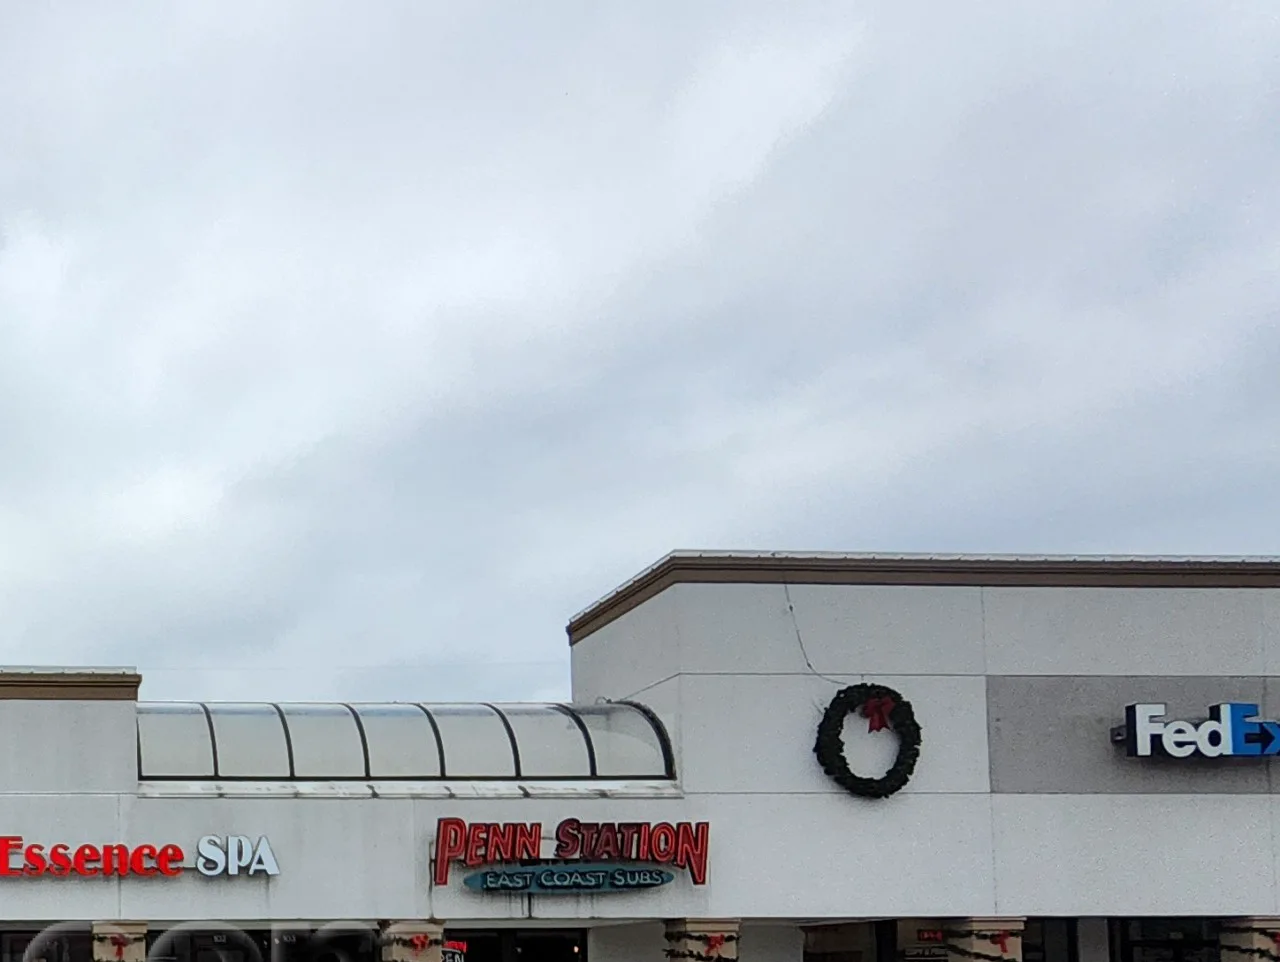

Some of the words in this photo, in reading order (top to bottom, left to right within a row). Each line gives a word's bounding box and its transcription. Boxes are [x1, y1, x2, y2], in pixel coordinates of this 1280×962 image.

[196, 833, 280, 877] SPA
[434, 817, 542, 886] PENN
[554, 817, 709, 885] STATION
[484, 872, 532, 887] EAST
[540, 871, 605, 886] COAST
[614, 869, 664, 885] SUBS
